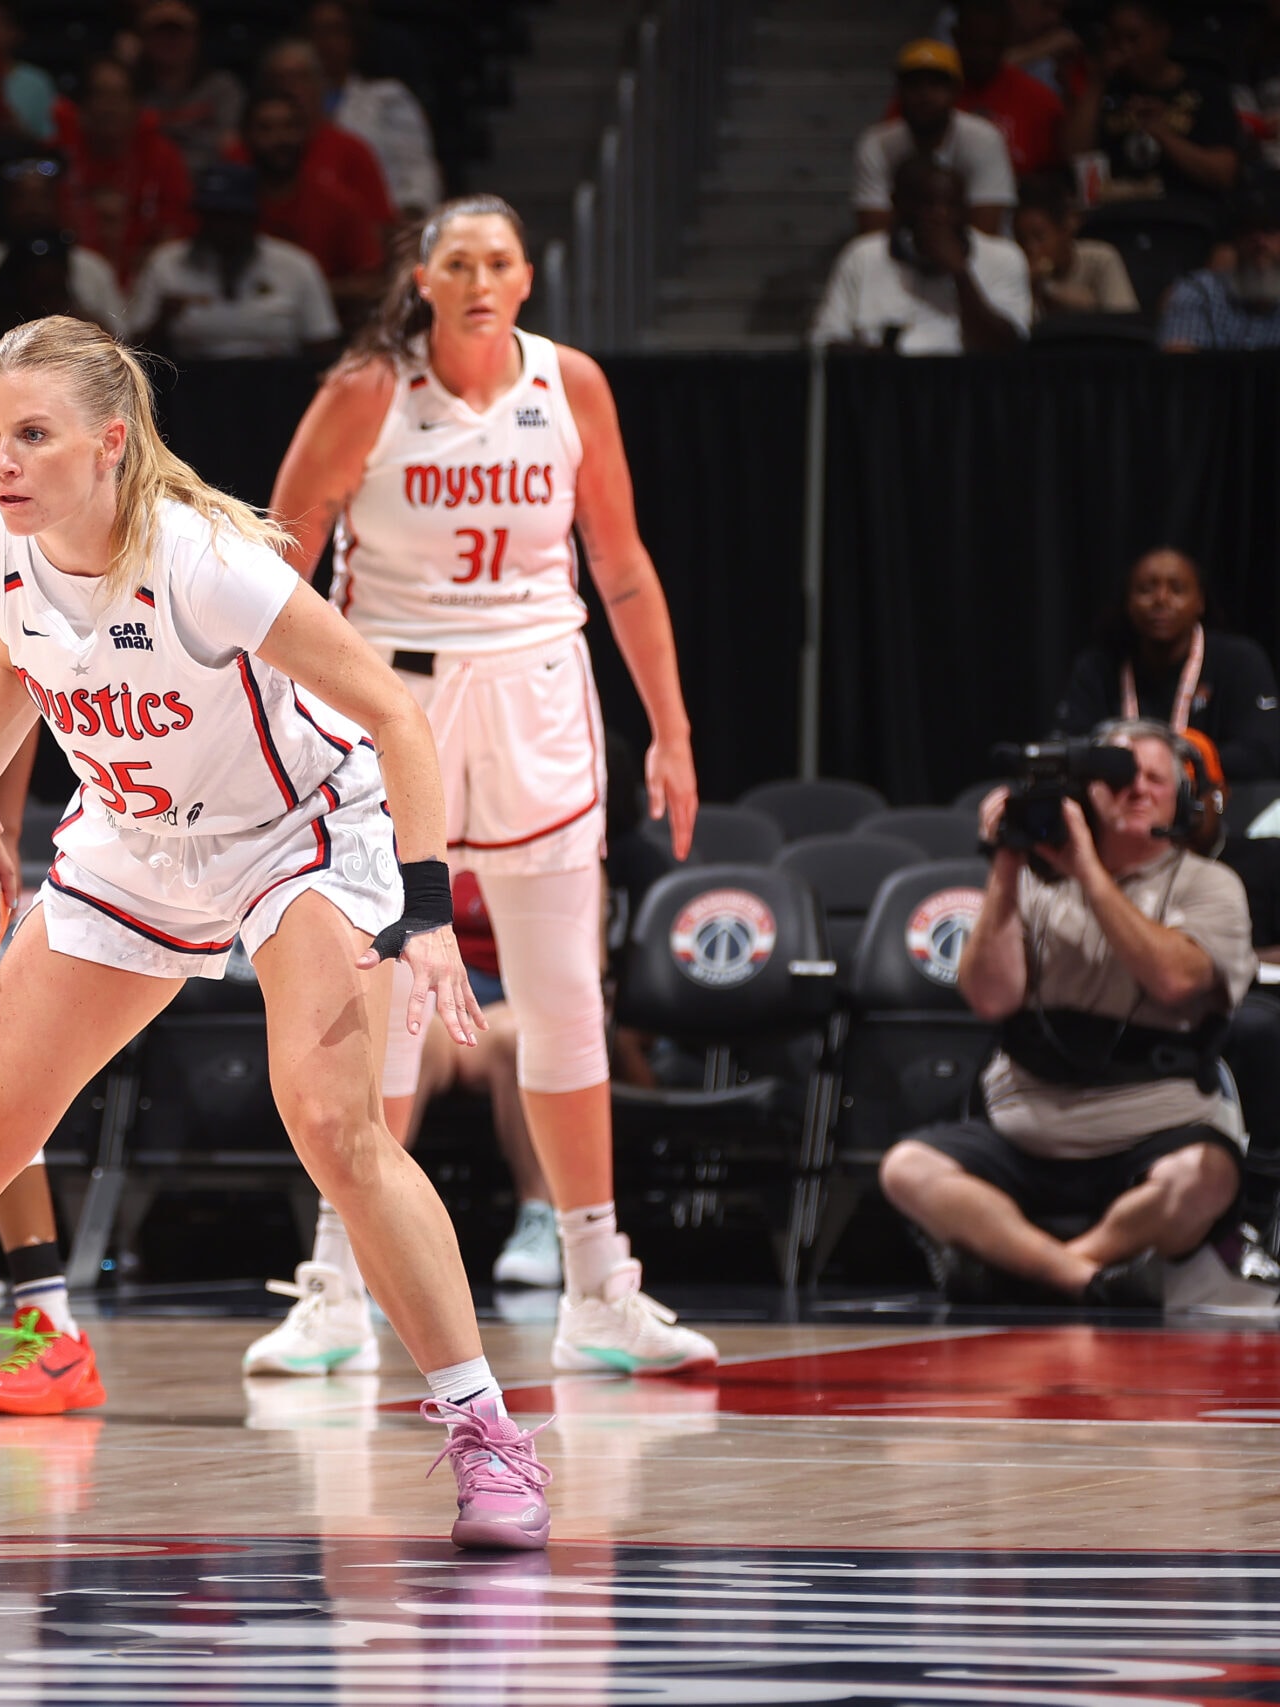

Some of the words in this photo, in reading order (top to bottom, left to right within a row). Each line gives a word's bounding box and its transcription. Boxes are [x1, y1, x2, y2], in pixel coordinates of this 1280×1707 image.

[451, 527, 509, 586] 31
[109, 622, 147, 638] CAR
[113, 635, 154, 652] max
[71, 749, 173, 819] 35
